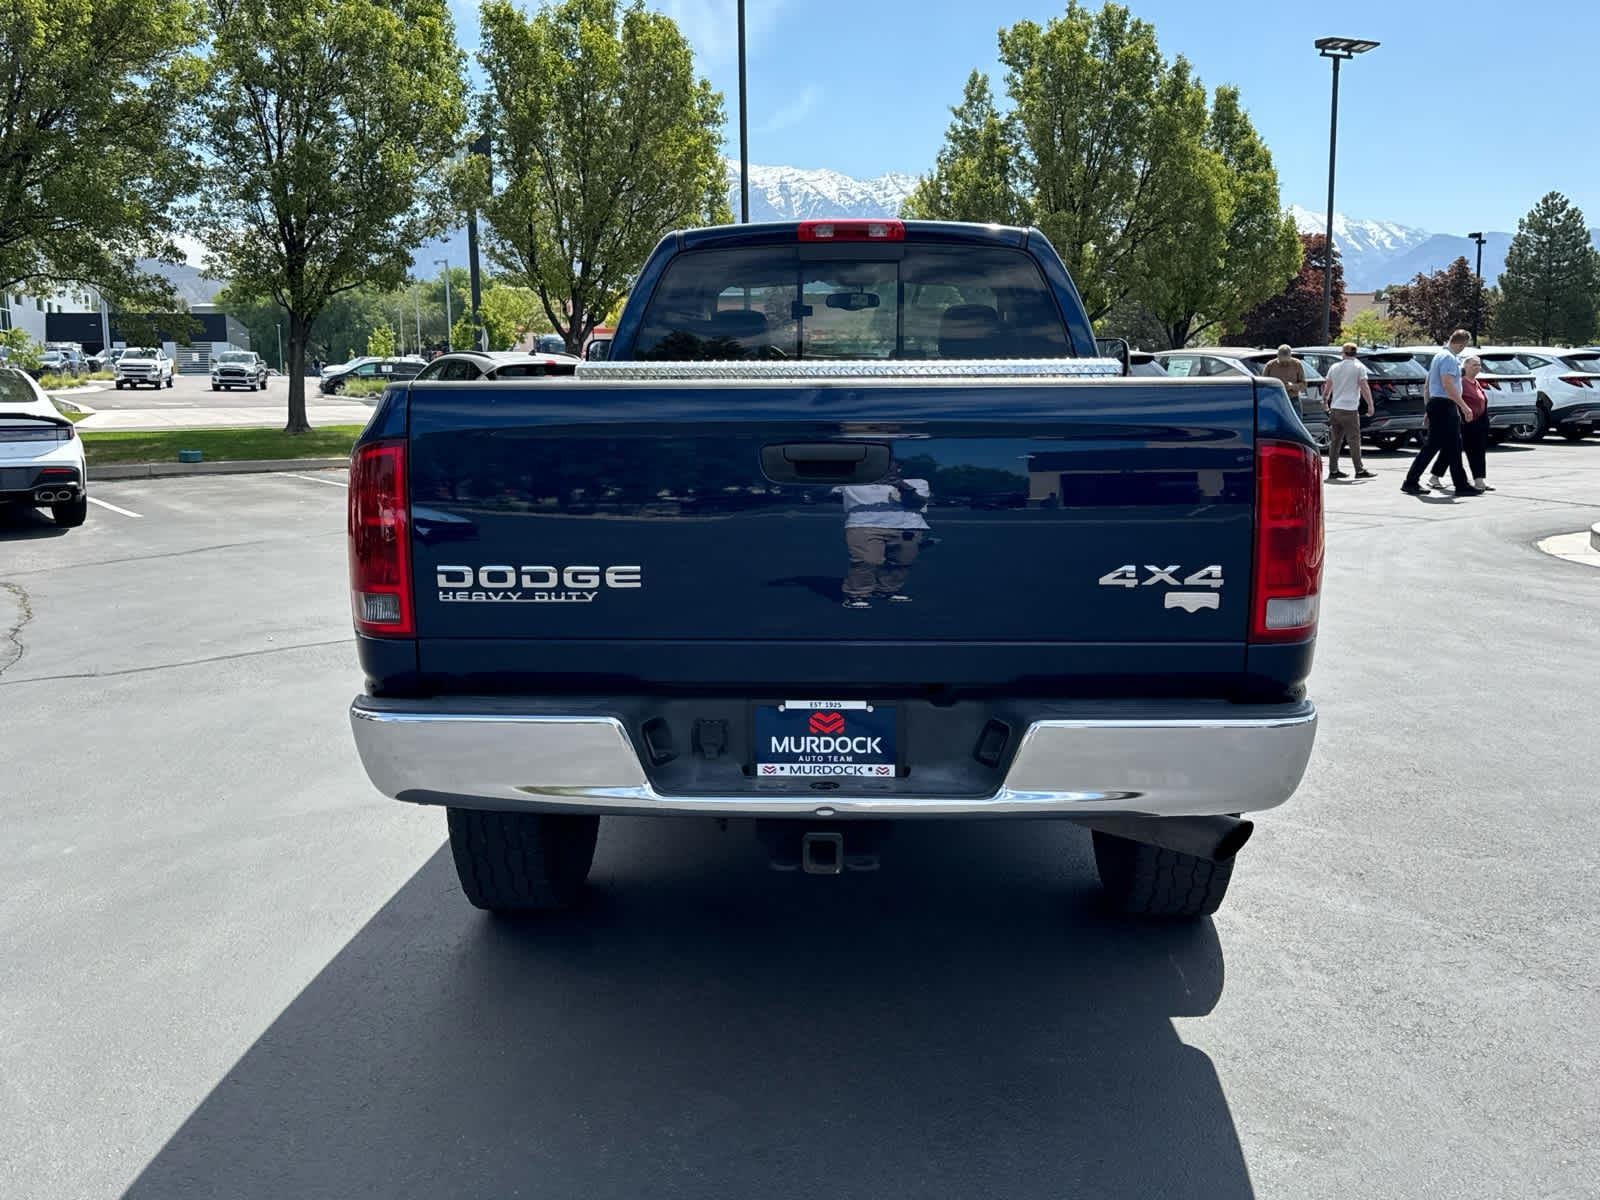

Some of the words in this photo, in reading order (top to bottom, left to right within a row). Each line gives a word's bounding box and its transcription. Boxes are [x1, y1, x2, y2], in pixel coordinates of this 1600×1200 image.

[436, 565, 642, 588] DODGE
[439, 591, 522, 602] HEAVY
[535, 591, 598, 602] DUTY
[771, 736, 883, 754] MURDOCK
[789, 765, 863, 775] MURDOCK
